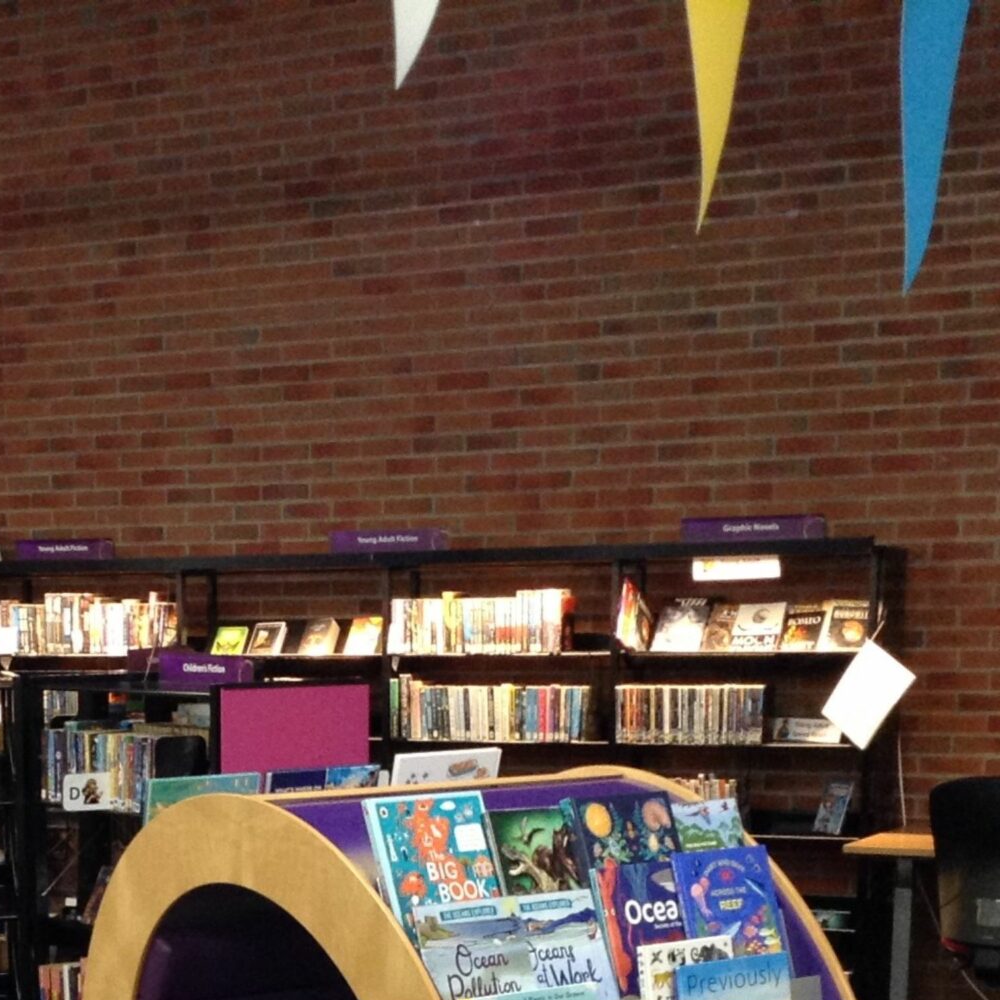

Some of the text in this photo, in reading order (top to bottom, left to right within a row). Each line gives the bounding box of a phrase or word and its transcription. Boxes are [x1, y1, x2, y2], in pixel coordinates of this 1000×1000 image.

[396, 534, 418, 542] Fiction
[722, 522, 780, 533] Graphic Novels
[182, 663, 226, 673] Children's Fiction
[69, 786, 80, 801] D
[426, 860, 459, 881] BIG
[437, 879, 490, 903] BOOK
[625, 899, 679, 925] Ocea
[455, 944, 510, 977] Ocean
[536, 958, 603, 987] at Work
[686, 967, 783, 996] Previously
